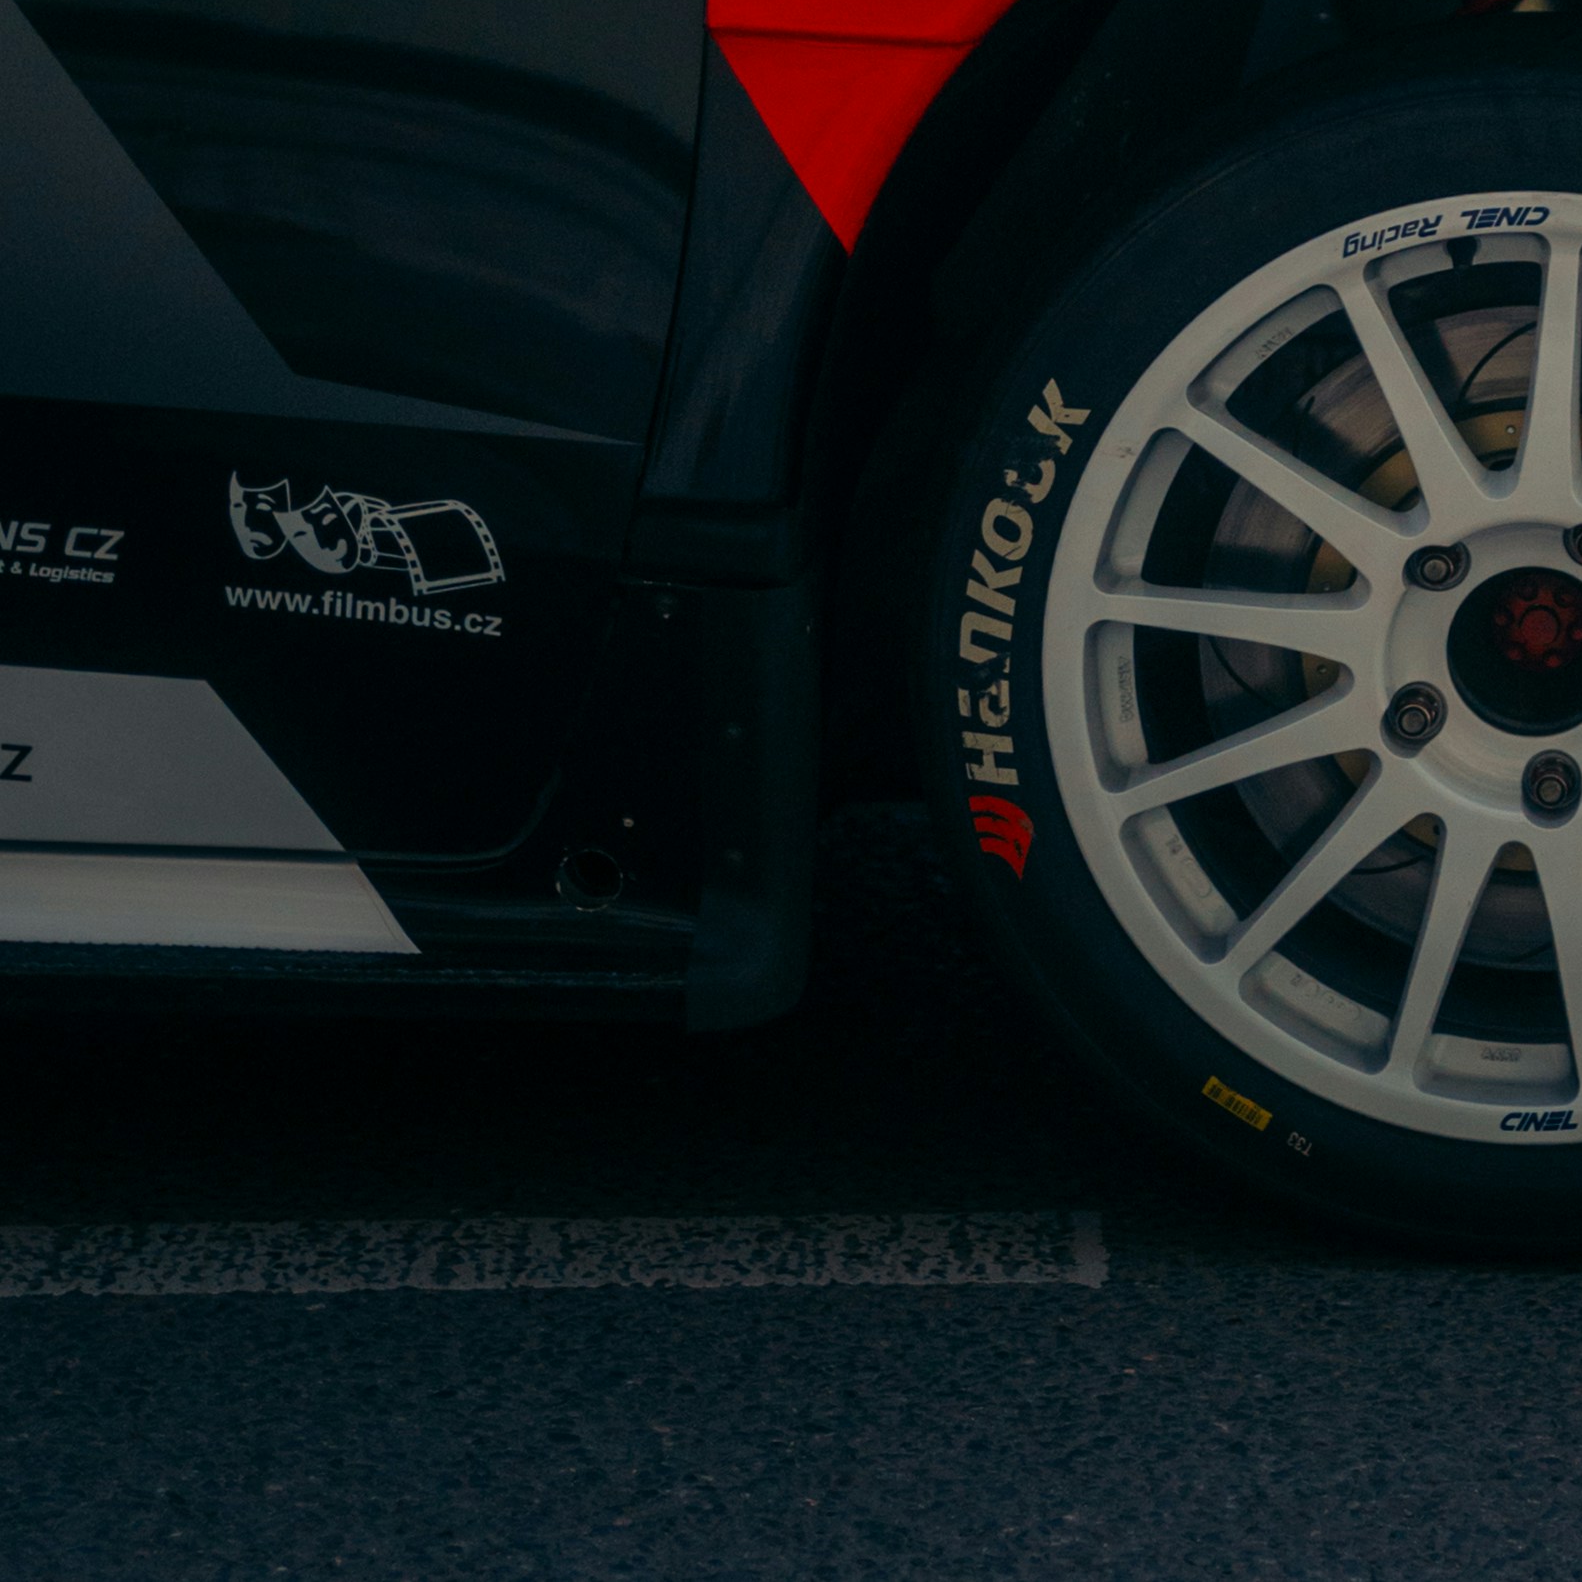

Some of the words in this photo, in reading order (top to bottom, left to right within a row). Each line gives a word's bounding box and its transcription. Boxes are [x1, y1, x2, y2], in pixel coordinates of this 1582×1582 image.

[1459, 206, 1551, 231] CINEL
[1342, 214, 1444, 259] Racing
[64, 526, 126, 561] CZ
[29, 562, 116, 584] Logistics
[224, 585, 503, 637] www.filmbus.cz
[1500, 1110, 1579, 1132] CINEL
[1286, 1130, 1313, 1157] T33
